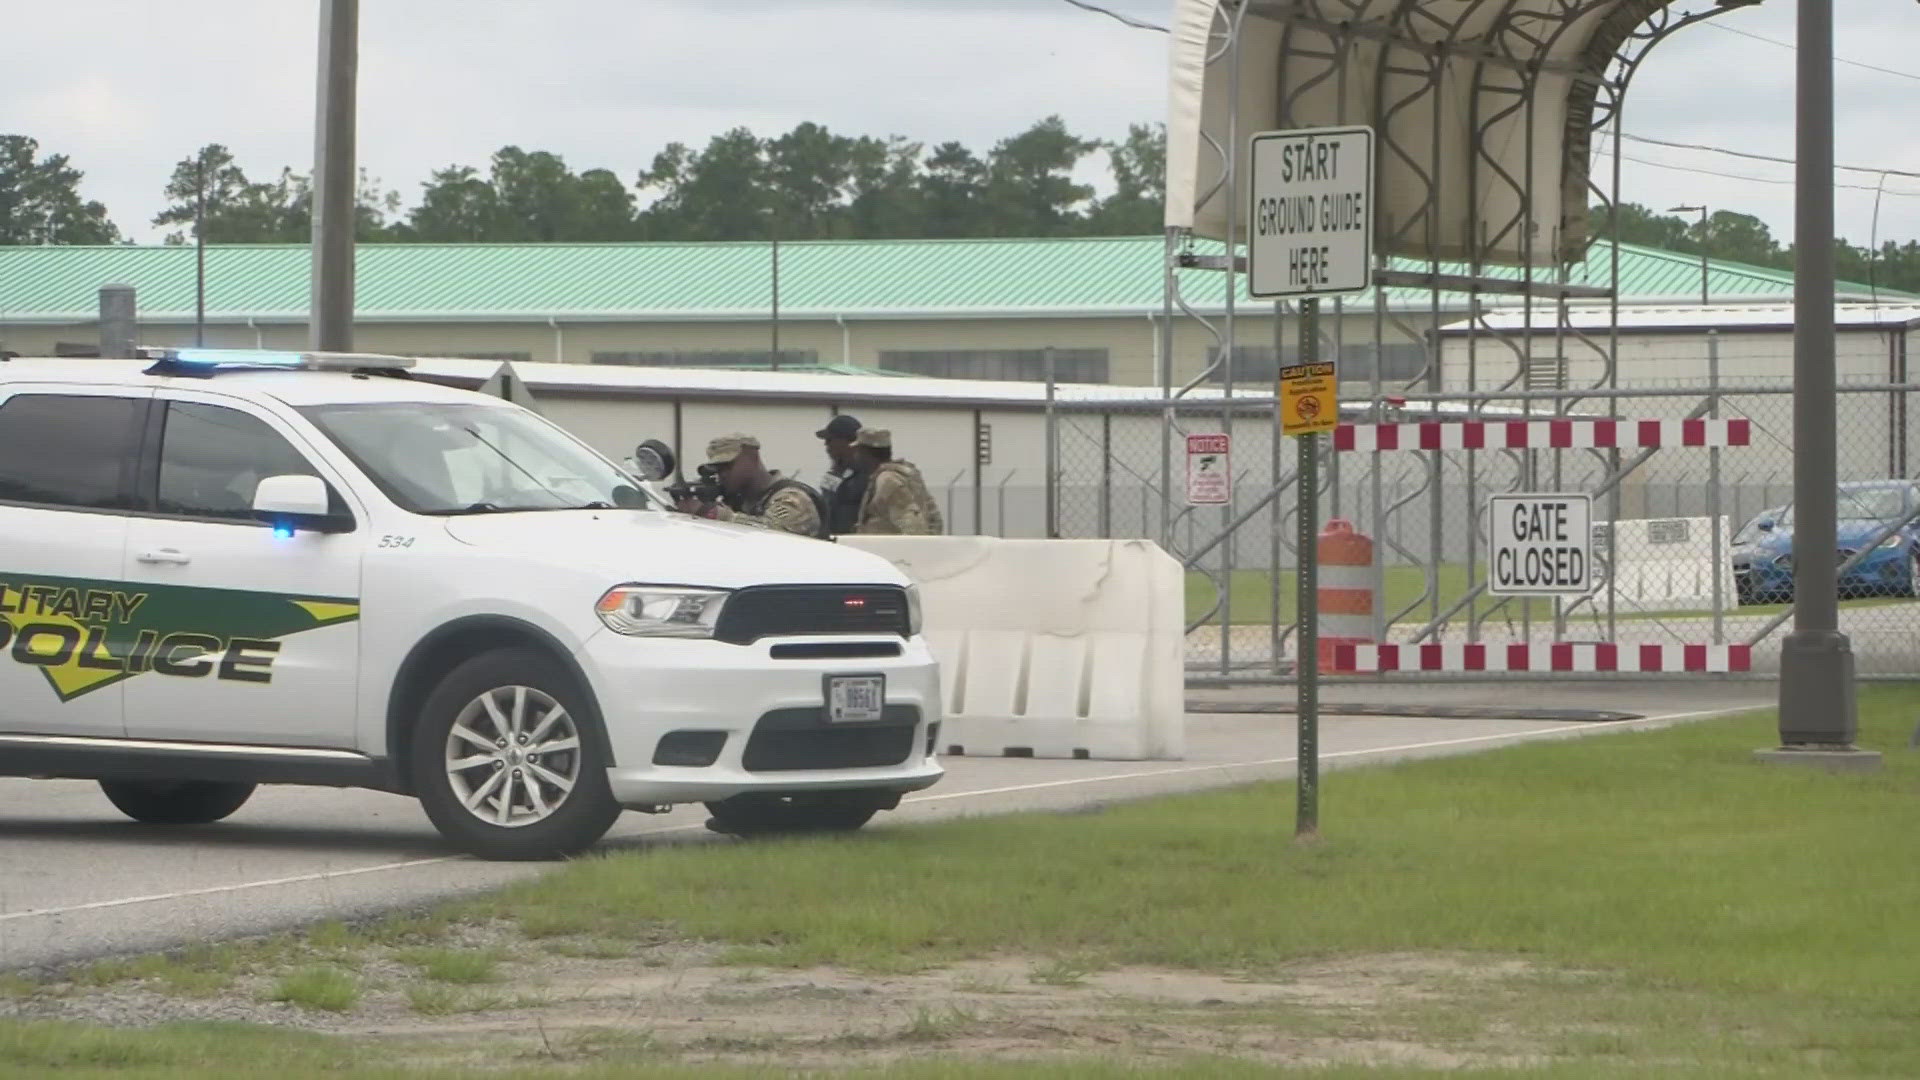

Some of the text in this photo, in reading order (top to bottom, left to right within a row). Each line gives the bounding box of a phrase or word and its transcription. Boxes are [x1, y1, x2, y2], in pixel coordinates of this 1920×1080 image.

[1282, 141, 1340, 183] START
[1258, 192, 1362, 235] GROUND GUIDE
[1289, 247, 1329, 286] HERE
[1282, 363, 1333, 379] CAUTION
[1189, 440, 1227, 452] NOTICE
[377, 535, 416, 548] 534
[1512, 503, 1567, 541] GATE
[1497, 547, 1583, 586] CLOSED
[0, 617, 281, 684] OLICE
